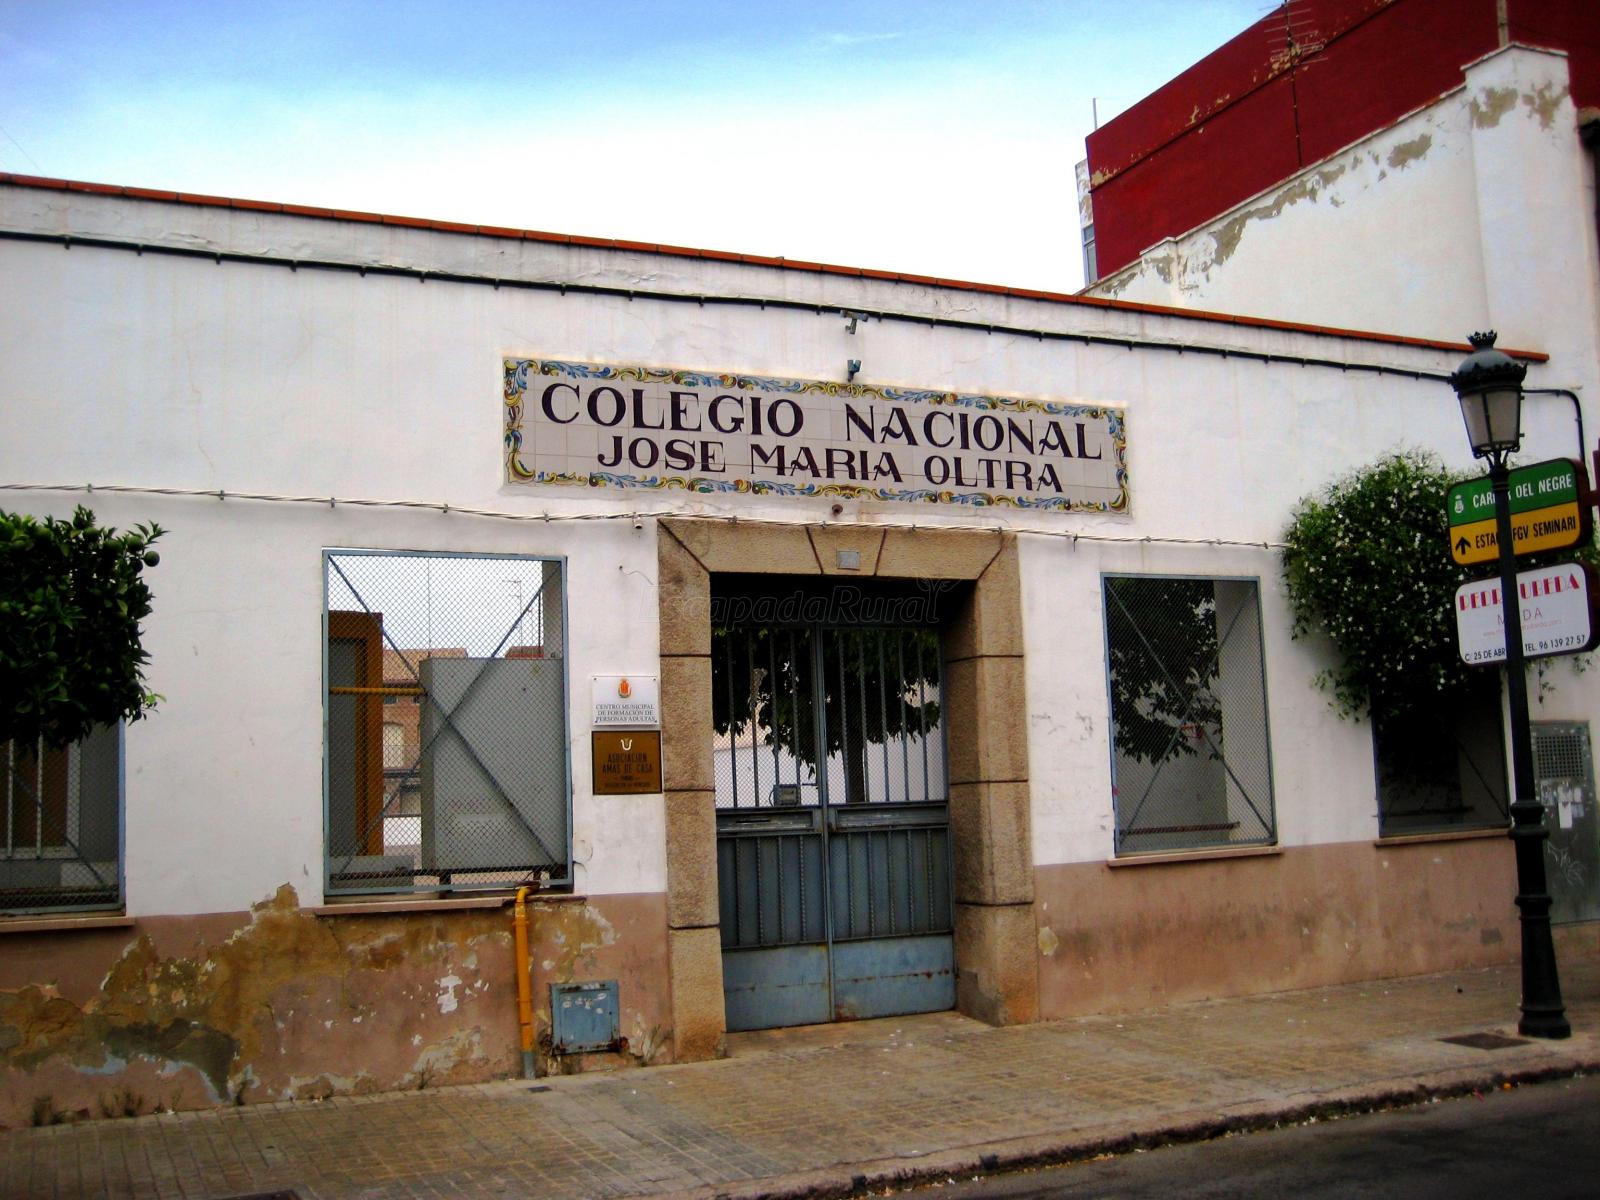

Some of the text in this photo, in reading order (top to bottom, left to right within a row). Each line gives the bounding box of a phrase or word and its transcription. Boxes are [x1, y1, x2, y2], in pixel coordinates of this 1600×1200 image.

[541, 383, 1102, 459] COLEGIO NACIONAL
[597, 436, 1064, 493] JOSE MARIA OLTRA
[1515, 483, 1534, 499] DEL
[1538, 473, 1573, 493] NEGRE
[1512, 525, 1529, 541] FGV
[1533, 516, 1576, 538] SEMINARI
[1474, 651, 1482, 660] 25
[1483, 650, 1492, 659] DE
[1539, 640, 1548, 650] 96
[1550, 638, 1564, 648] 139
[1565, 635, 1574, 646] 27
[1576, 634, 1585, 644] 57
